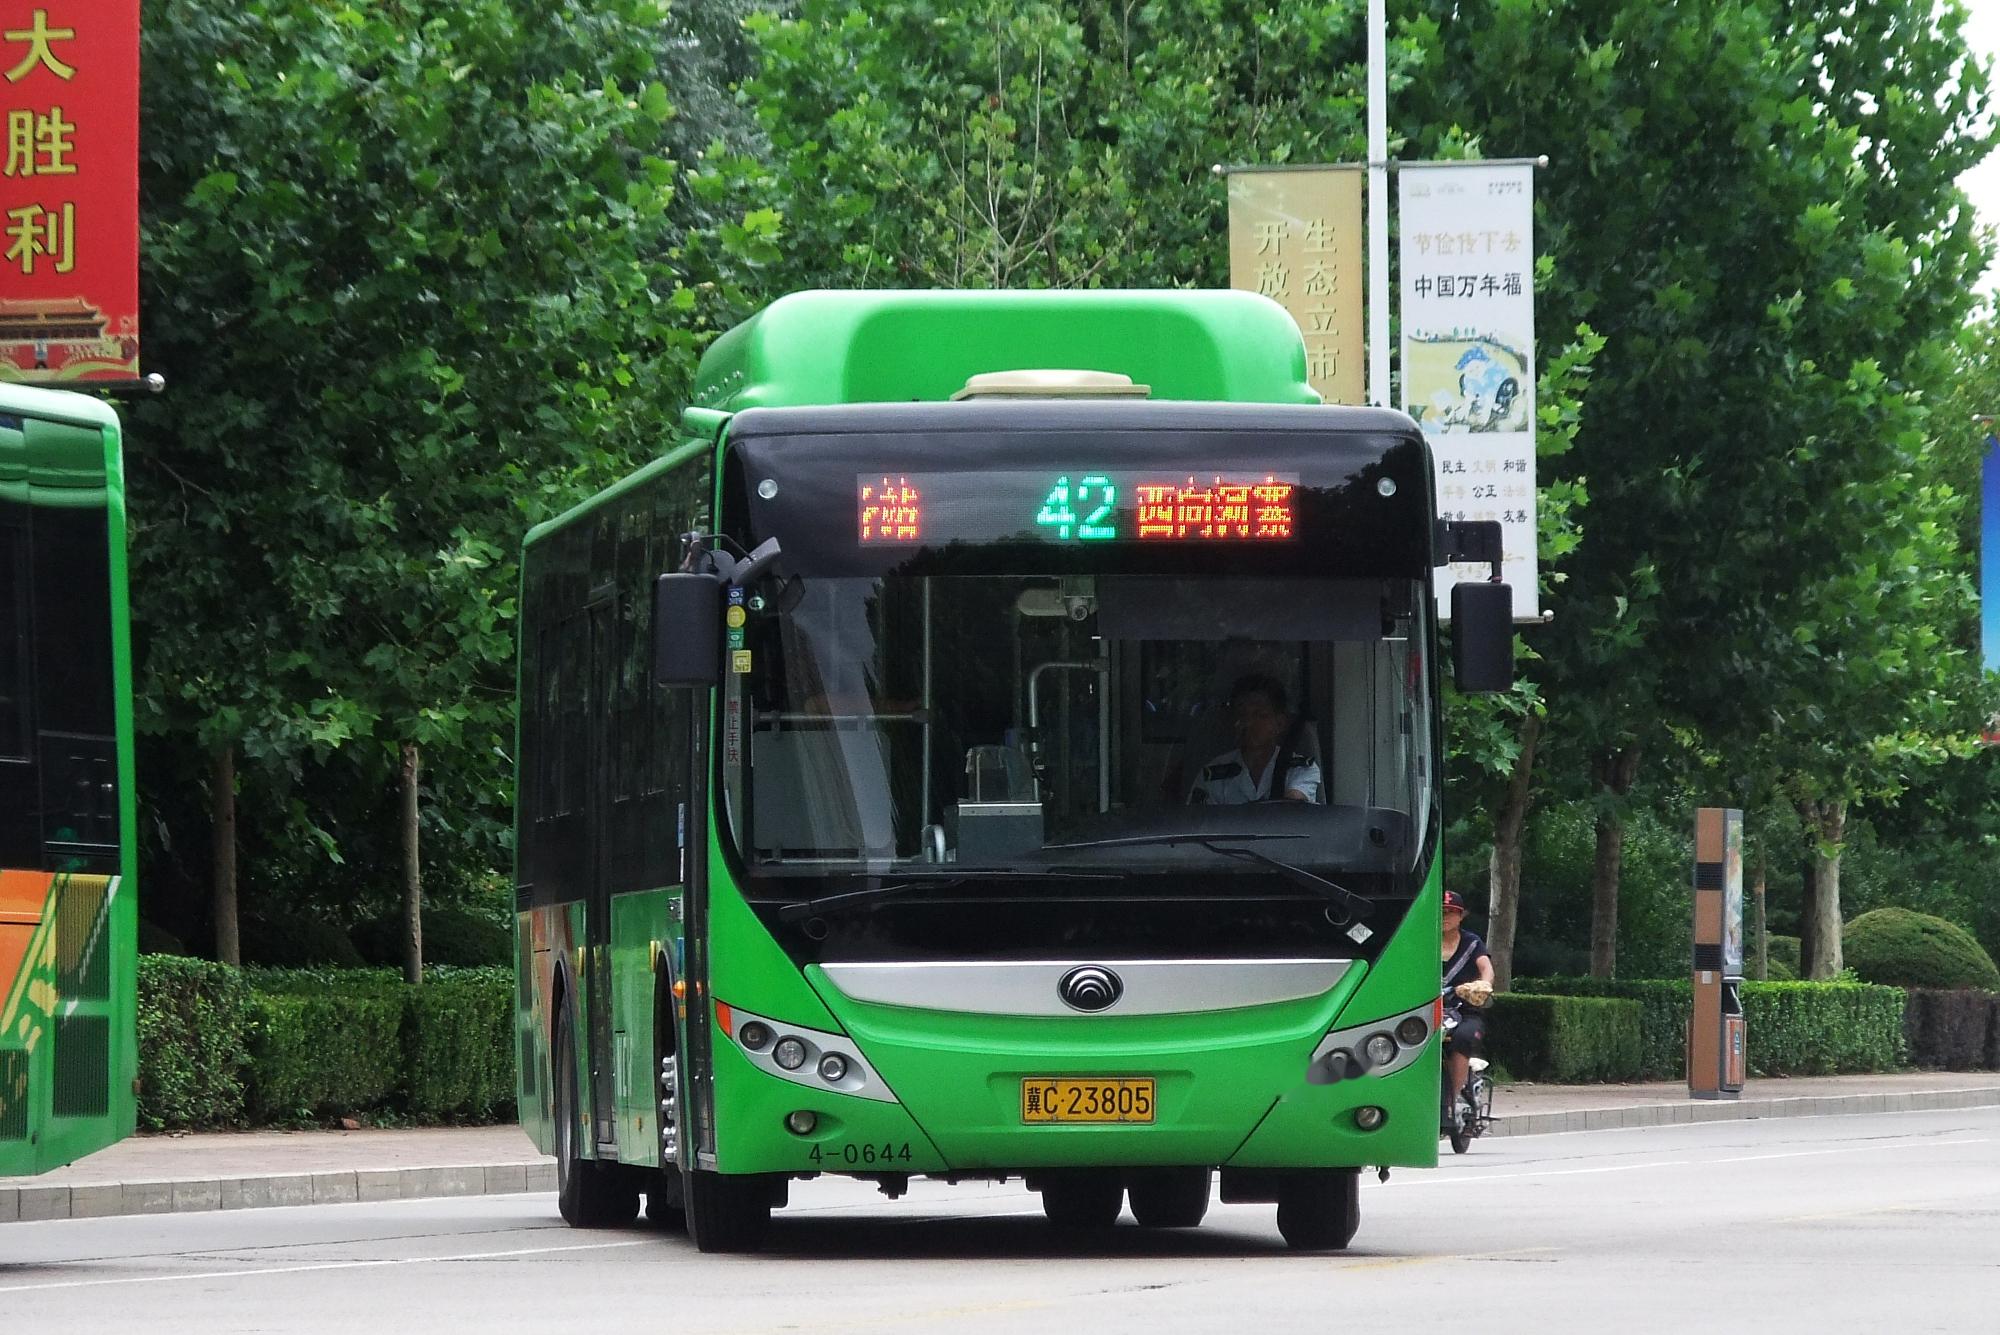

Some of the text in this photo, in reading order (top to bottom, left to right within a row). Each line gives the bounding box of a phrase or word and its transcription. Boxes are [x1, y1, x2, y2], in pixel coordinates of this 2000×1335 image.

[3, 8, 78, 274] 大胜利
[1414, 272, 1523, 299] 中国万年福
[1303, 218, 1341, 404] 生态立市
[1442, 460, 1466, 474] 民主
[1503, 459, 1528, 473] 和谐
[1472, 484, 1498, 499] 公正
[1037, 475, 1116, 540] 42
[1503, 509, 1528, 523] 友善
[808, 1142, 912, 1164] 4-0644
